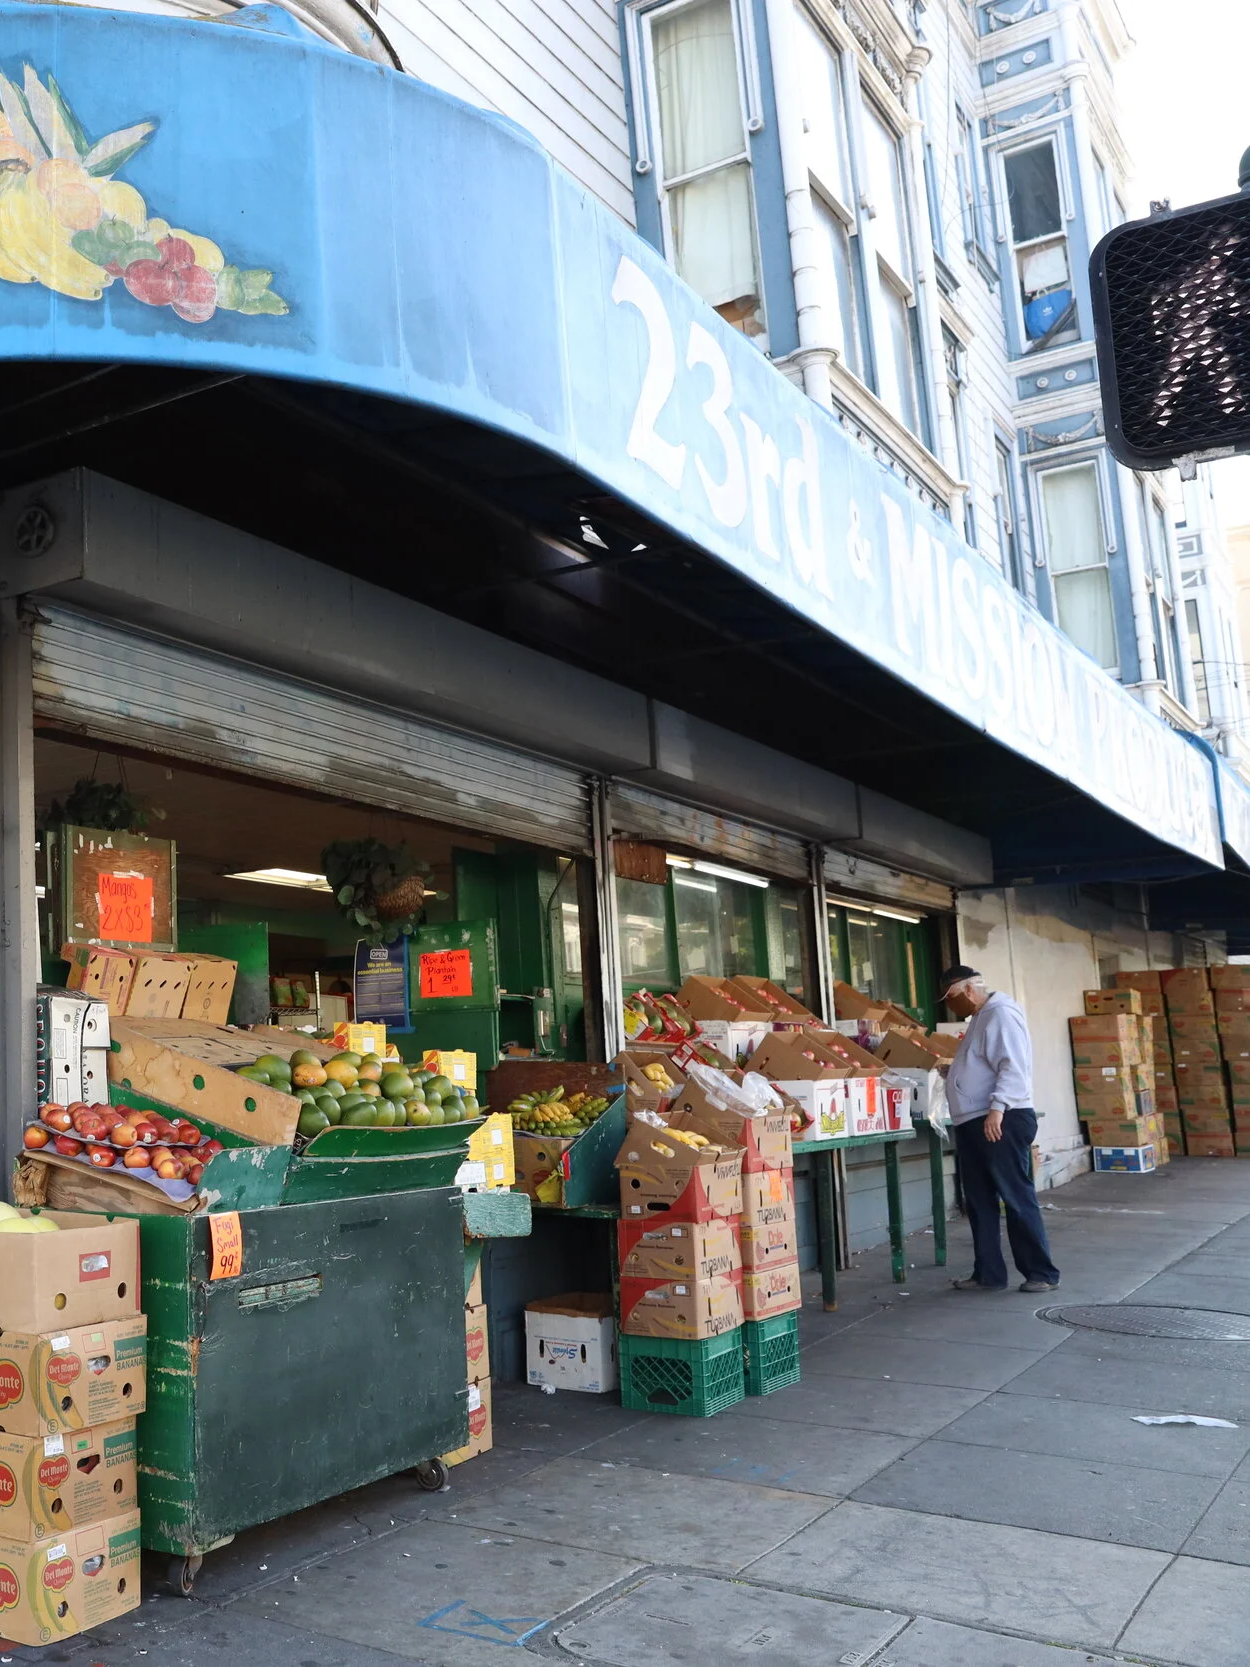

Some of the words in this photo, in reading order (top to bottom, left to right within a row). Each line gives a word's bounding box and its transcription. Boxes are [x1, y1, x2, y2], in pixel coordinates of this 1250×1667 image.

[612, 255, 833, 602] 23rd
[847, 500, 875, 584] &
[880, 493, 1076, 772] MISSION
[371, 951, 387, 959] OPEN
[72, 1007, 82, 1034] CAUTION
[217, 1234, 239, 1253] Small
[768, 1230, 783, 1246] Dole
